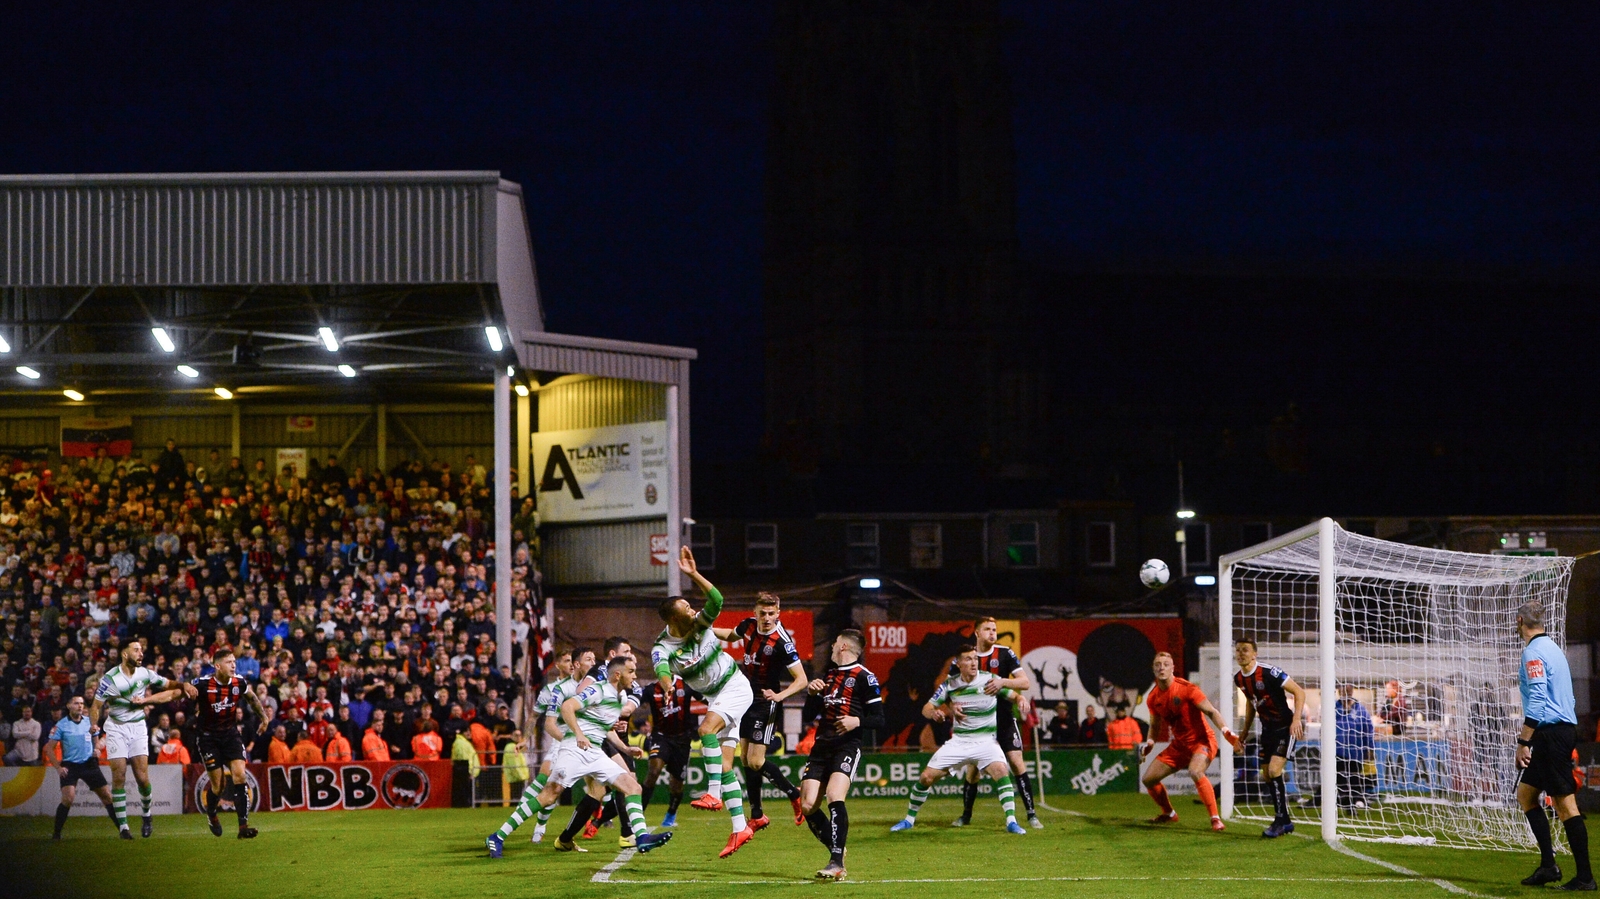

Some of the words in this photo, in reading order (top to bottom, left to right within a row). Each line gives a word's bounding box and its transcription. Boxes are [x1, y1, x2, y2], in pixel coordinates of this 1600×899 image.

[540, 443, 630, 500] ATLANTIC
[869, 625, 907, 647] 1980
[268, 764, 378, 812] NBB
[851, 788, 861, 797] A
[863, 786, 909, 796] CASINO
